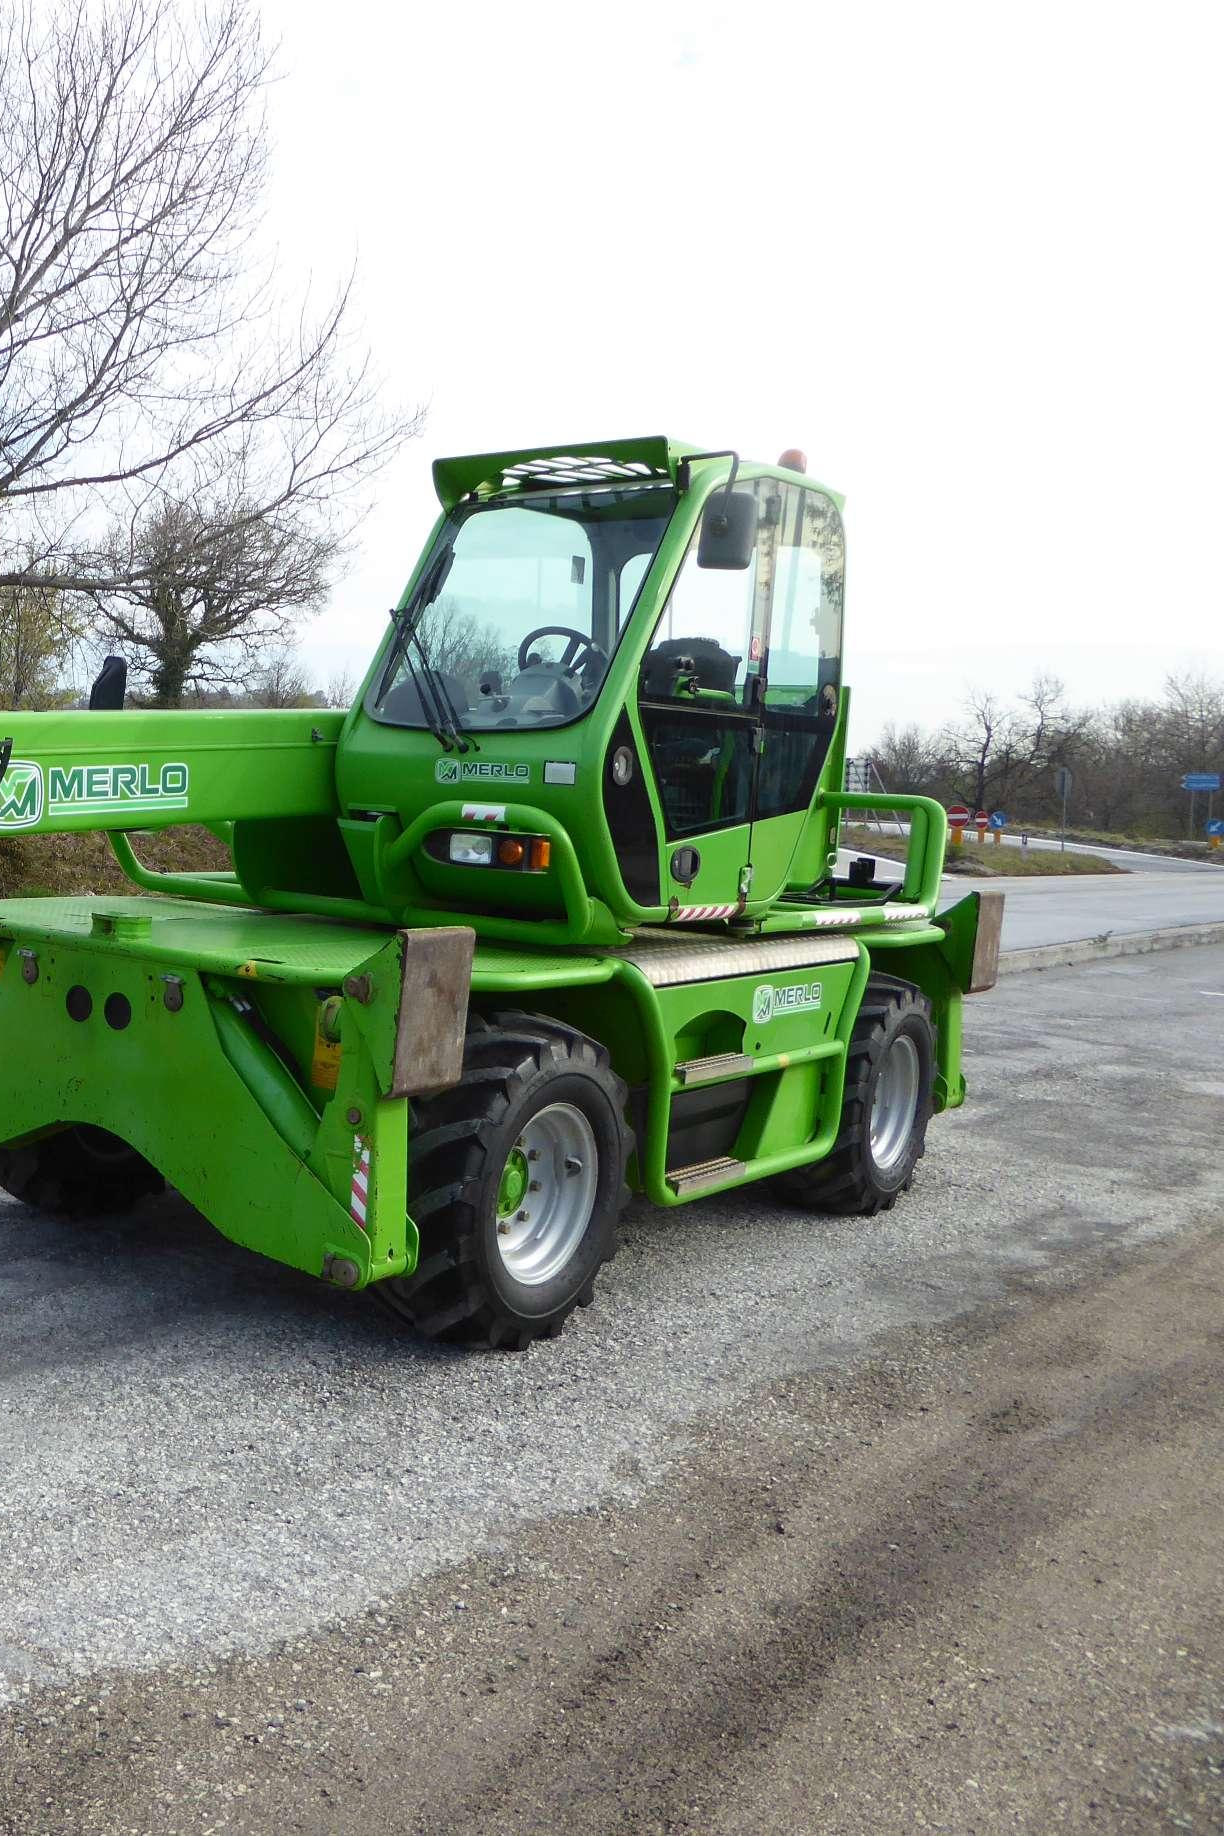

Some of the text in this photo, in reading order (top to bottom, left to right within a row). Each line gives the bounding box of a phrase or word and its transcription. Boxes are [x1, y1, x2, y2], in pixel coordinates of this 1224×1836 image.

[462, 762, 529, 777] MERLO
[49, 764, 188, 800] MERLO
[774, 983, 821, 1007] MERLO
